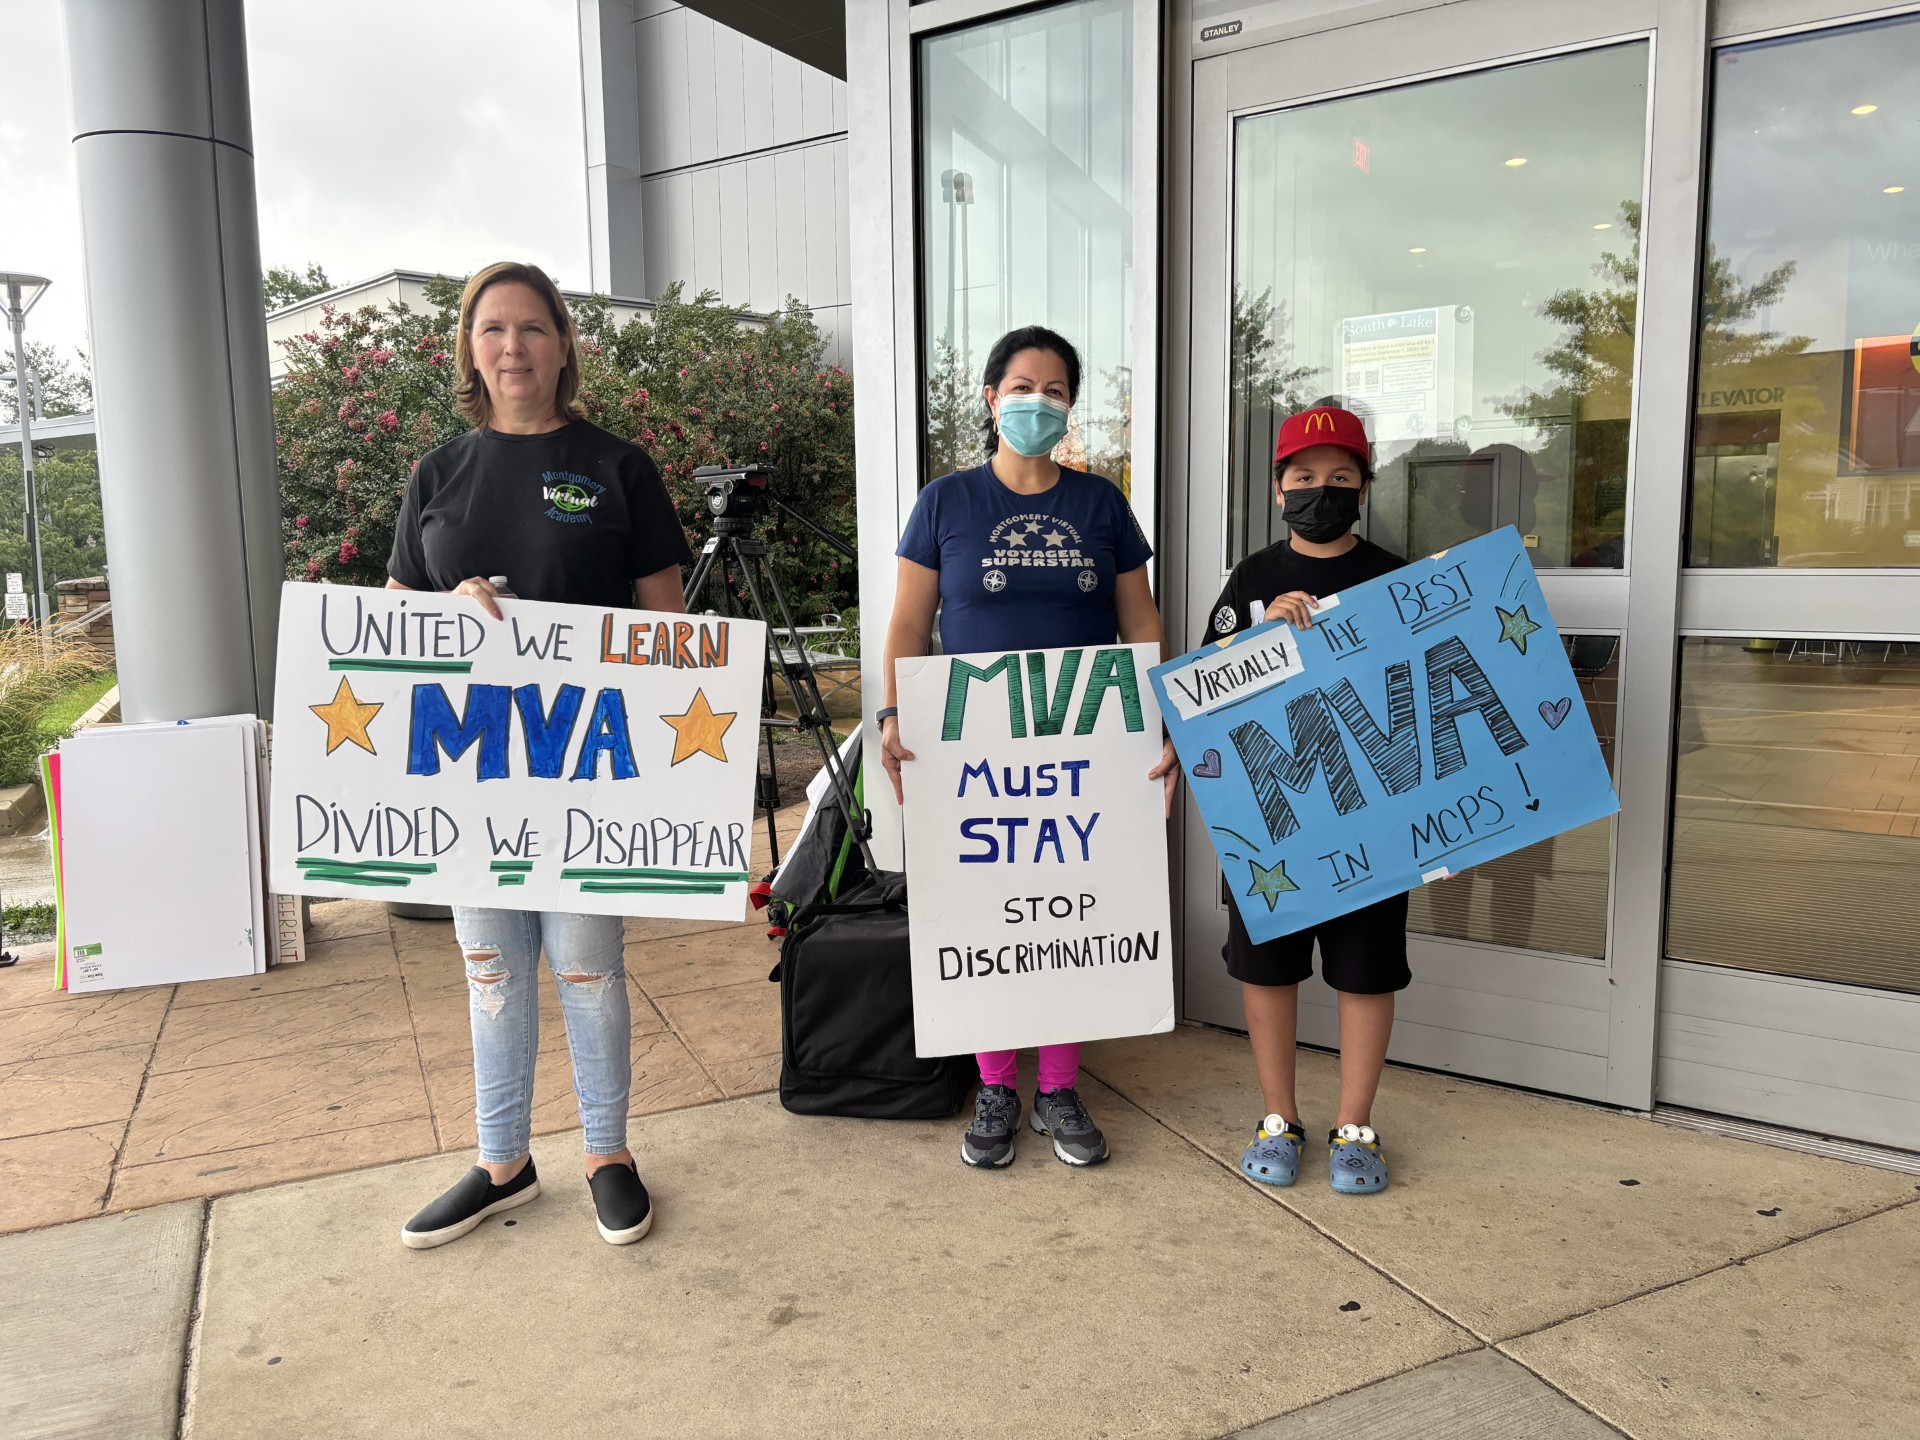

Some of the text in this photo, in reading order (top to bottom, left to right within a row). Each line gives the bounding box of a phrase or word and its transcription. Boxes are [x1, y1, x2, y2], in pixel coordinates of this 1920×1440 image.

[1203, 23, 1240, 39] STANLEY
[1346, 314, 1433, 337] South Lake
[1698, 386, 1786, 408] LEVATOR
[542, 470, 606, 495] Montgomery
[542, 486, 599, 508] Virtual
[543, 506, 593, 525] Academy
[988, 513, 1083, 545] MONTGOMERY VIRTUAL
[981, 557, 1095, 568] SUPERSTAR
[993, 549, 1082, 558] VOYAGER
[1312, 613, 1368, 653] THE
[1387, 560, 1476, 626] BEST
[511, 615, 573, 663] WE
[599, 612, 730, 669] LEARN
[941, 647, 1145, 742] MVA
[406, 682, 642, 783] MVA
[1228, 635, 1530, 846] MVA
[485, 816, 541, 859] WE
[958, 812, 1101, 864] STAY
[1317, 842, 1371, 887] IN
[1004, 893, 1097, 924] STOP
